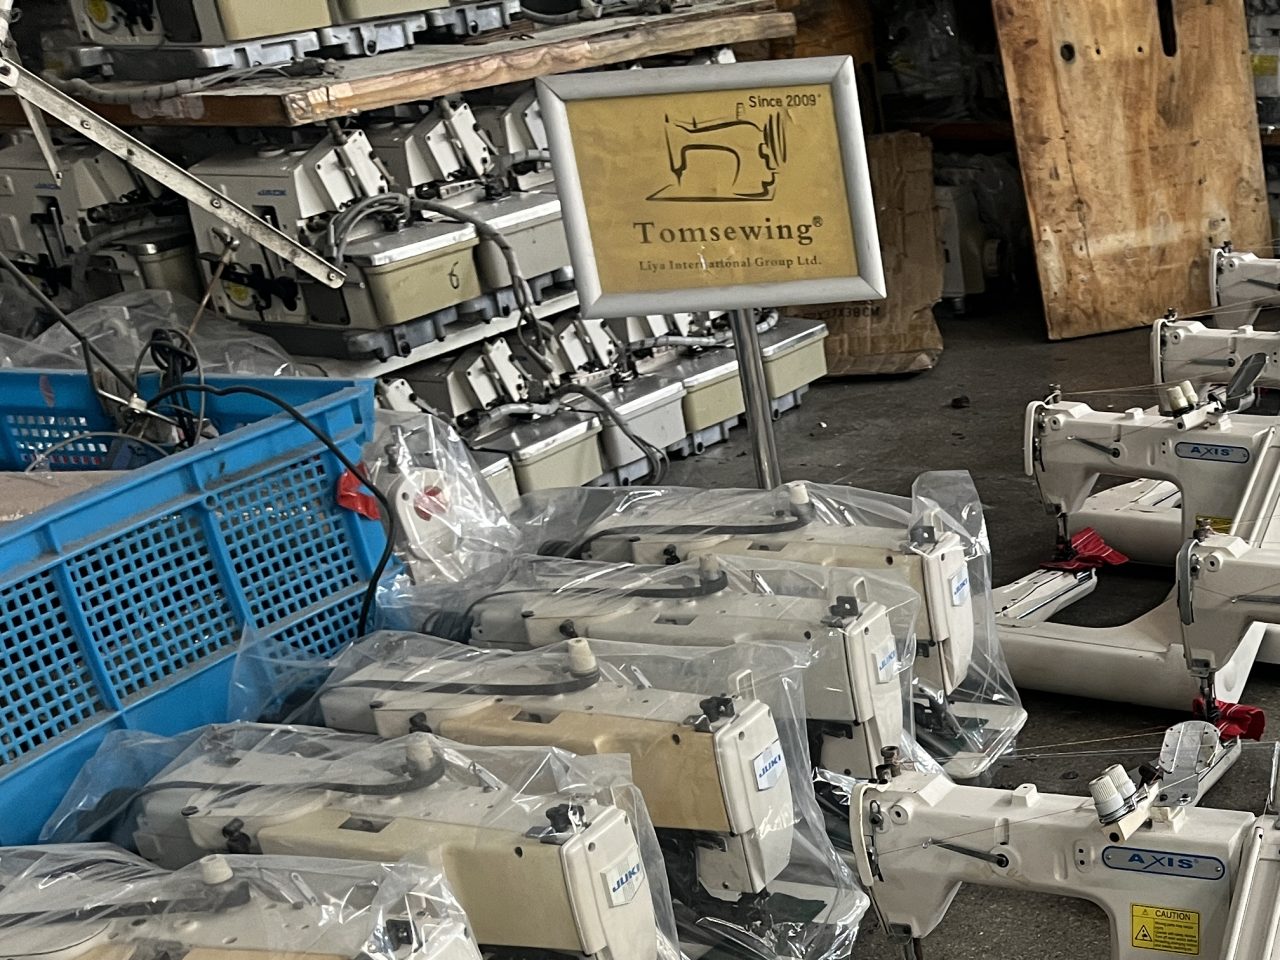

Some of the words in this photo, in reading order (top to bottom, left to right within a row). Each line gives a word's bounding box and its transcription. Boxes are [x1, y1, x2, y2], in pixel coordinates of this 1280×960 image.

[749, 95, 783, 108] Since
[786, 94, 816, 107] 2009
[639, 260, 666, 274] Liya
[669, 257, 751, 271] Interational
[754, 257, 793, 269] Group
[797, 255, 822, 266] Ltd.
[448, 261, 460, 289] 6
[1190, 445, 1231, 457] AXIS
[758, 754, 782, 778] JUKI
[1128, 853, 1194, 869] AXIS
[612, 863, 640, 893] JUKI
[1155, 909, 1191, 921] CAUTION
